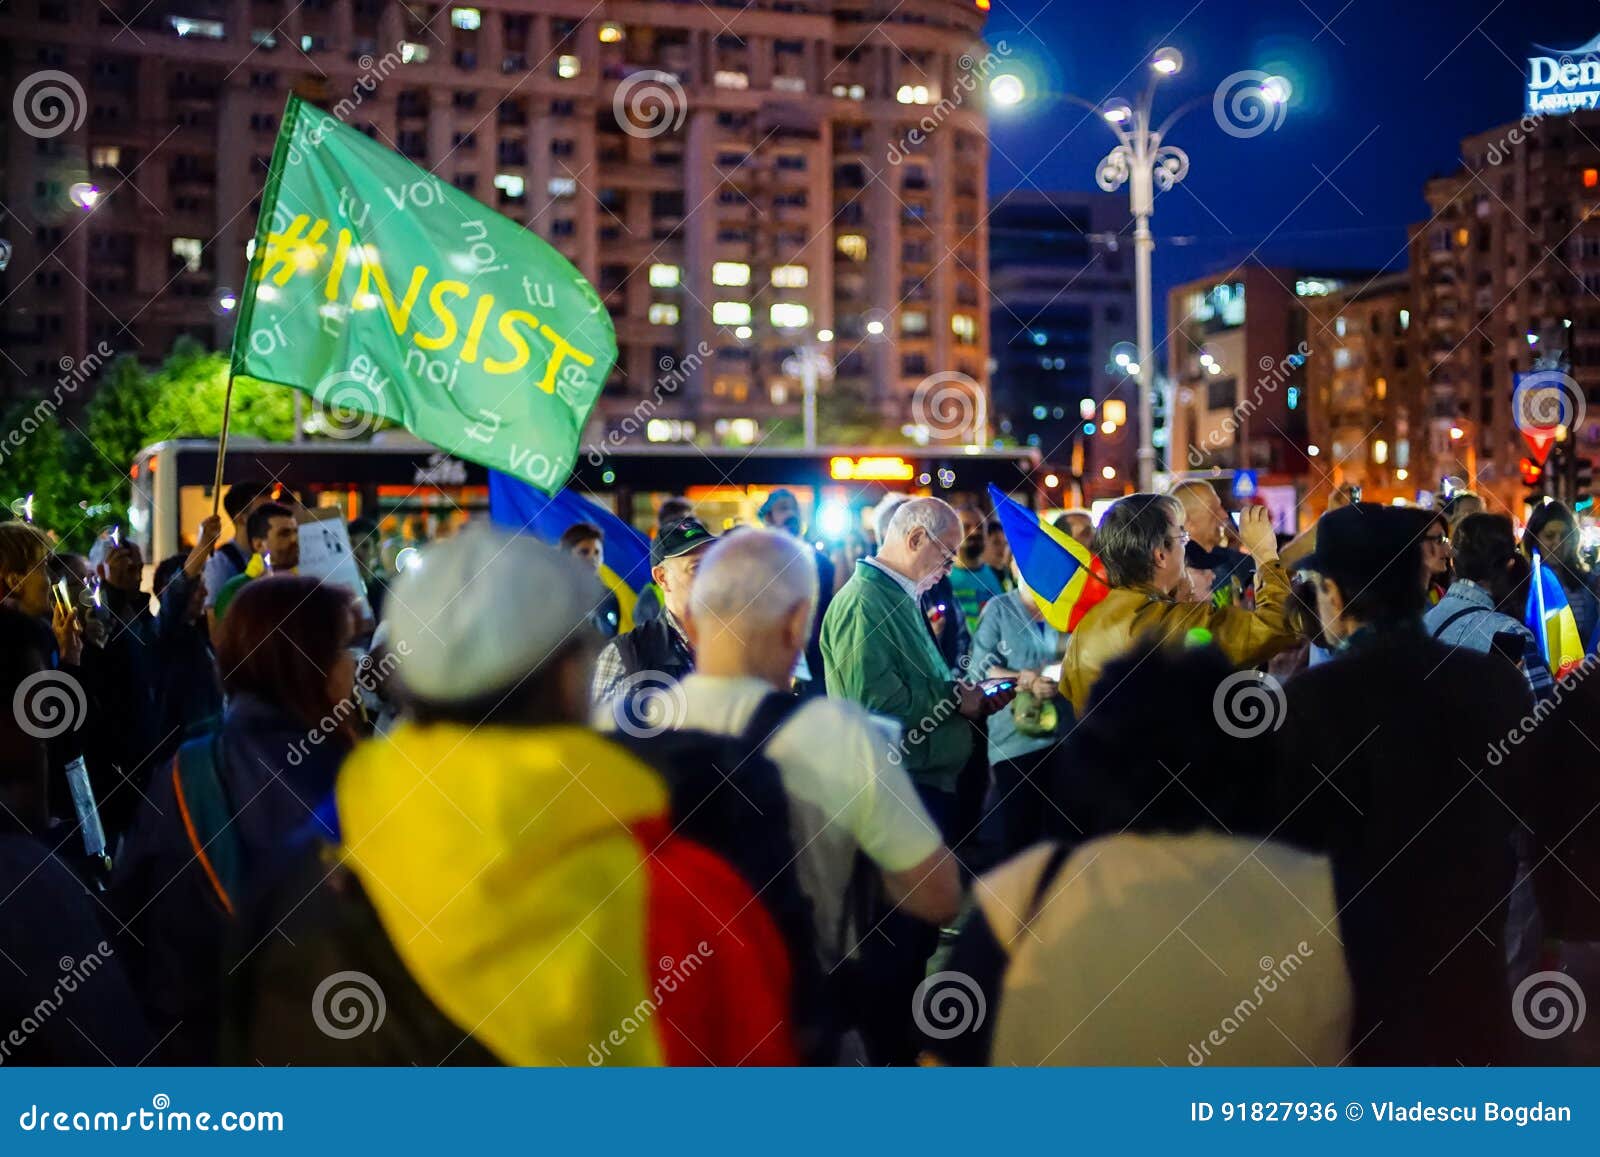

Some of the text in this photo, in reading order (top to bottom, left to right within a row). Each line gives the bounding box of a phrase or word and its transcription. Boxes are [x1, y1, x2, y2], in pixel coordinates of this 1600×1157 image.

[338, 186, 371, 228] tu
[384, 174, 444, 211] voi
[461, 219, 509, 273] noi
[253, 214, 595, 394] #INSIST
[522, 275, 556, 308] tu
[350, 354, 390, 394] eu
[404, 348, 461, 391] noi
[464, 408, 501, 443] tu
[509, 444, 562, 485] voi
